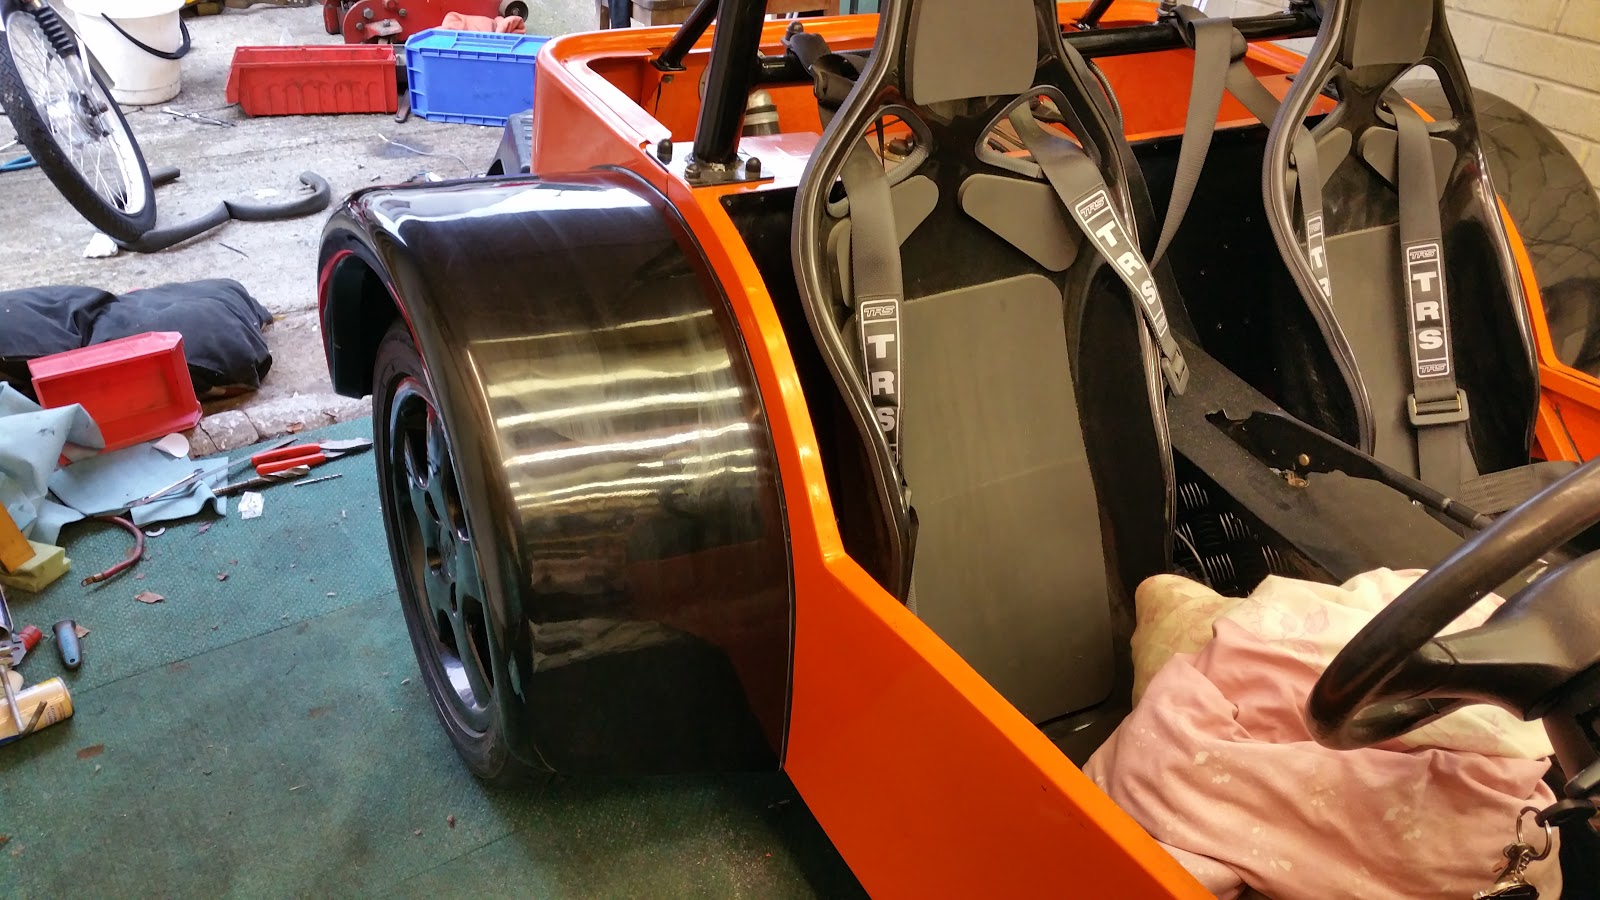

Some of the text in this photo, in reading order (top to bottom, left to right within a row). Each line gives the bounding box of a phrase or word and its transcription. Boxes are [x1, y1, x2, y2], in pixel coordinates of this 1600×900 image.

[1081, 196, 1105, 217] TRS
[1095, 219, 1157, 305] TRS
[1410, 248, 1437, 260] TRS
[864, 305, 896, 318] TRS
[1412, 270, 1443, 350] TRS
[1419, 363, 1447, 374] TRS
[867, 333, 896, 432] TRS
